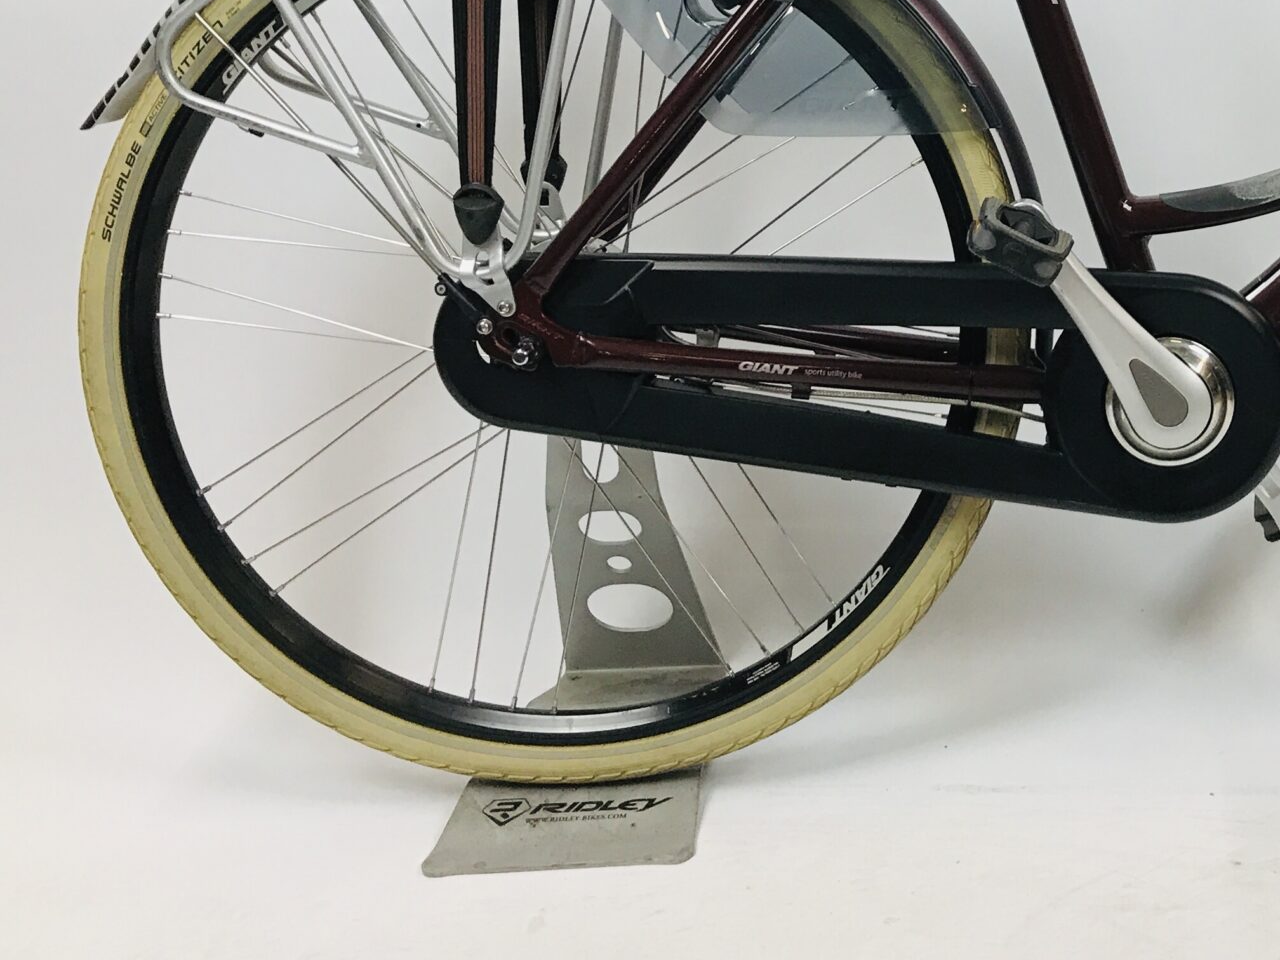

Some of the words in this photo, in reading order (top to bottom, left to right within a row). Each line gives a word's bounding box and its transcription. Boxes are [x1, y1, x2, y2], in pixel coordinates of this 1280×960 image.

[221, 18, 281, 90] GIANT
[101, 140, 143, 243] SCHWALBE
[738, 361, 799, 376] GIANT
[804, 368, 826, 377] sports
[827, 368, 846, 379] utility
[848, 371, 863, 379] bike
[831, 565, 887, 626] GIANT
[530, 797, 673, 815] RIDLEY
